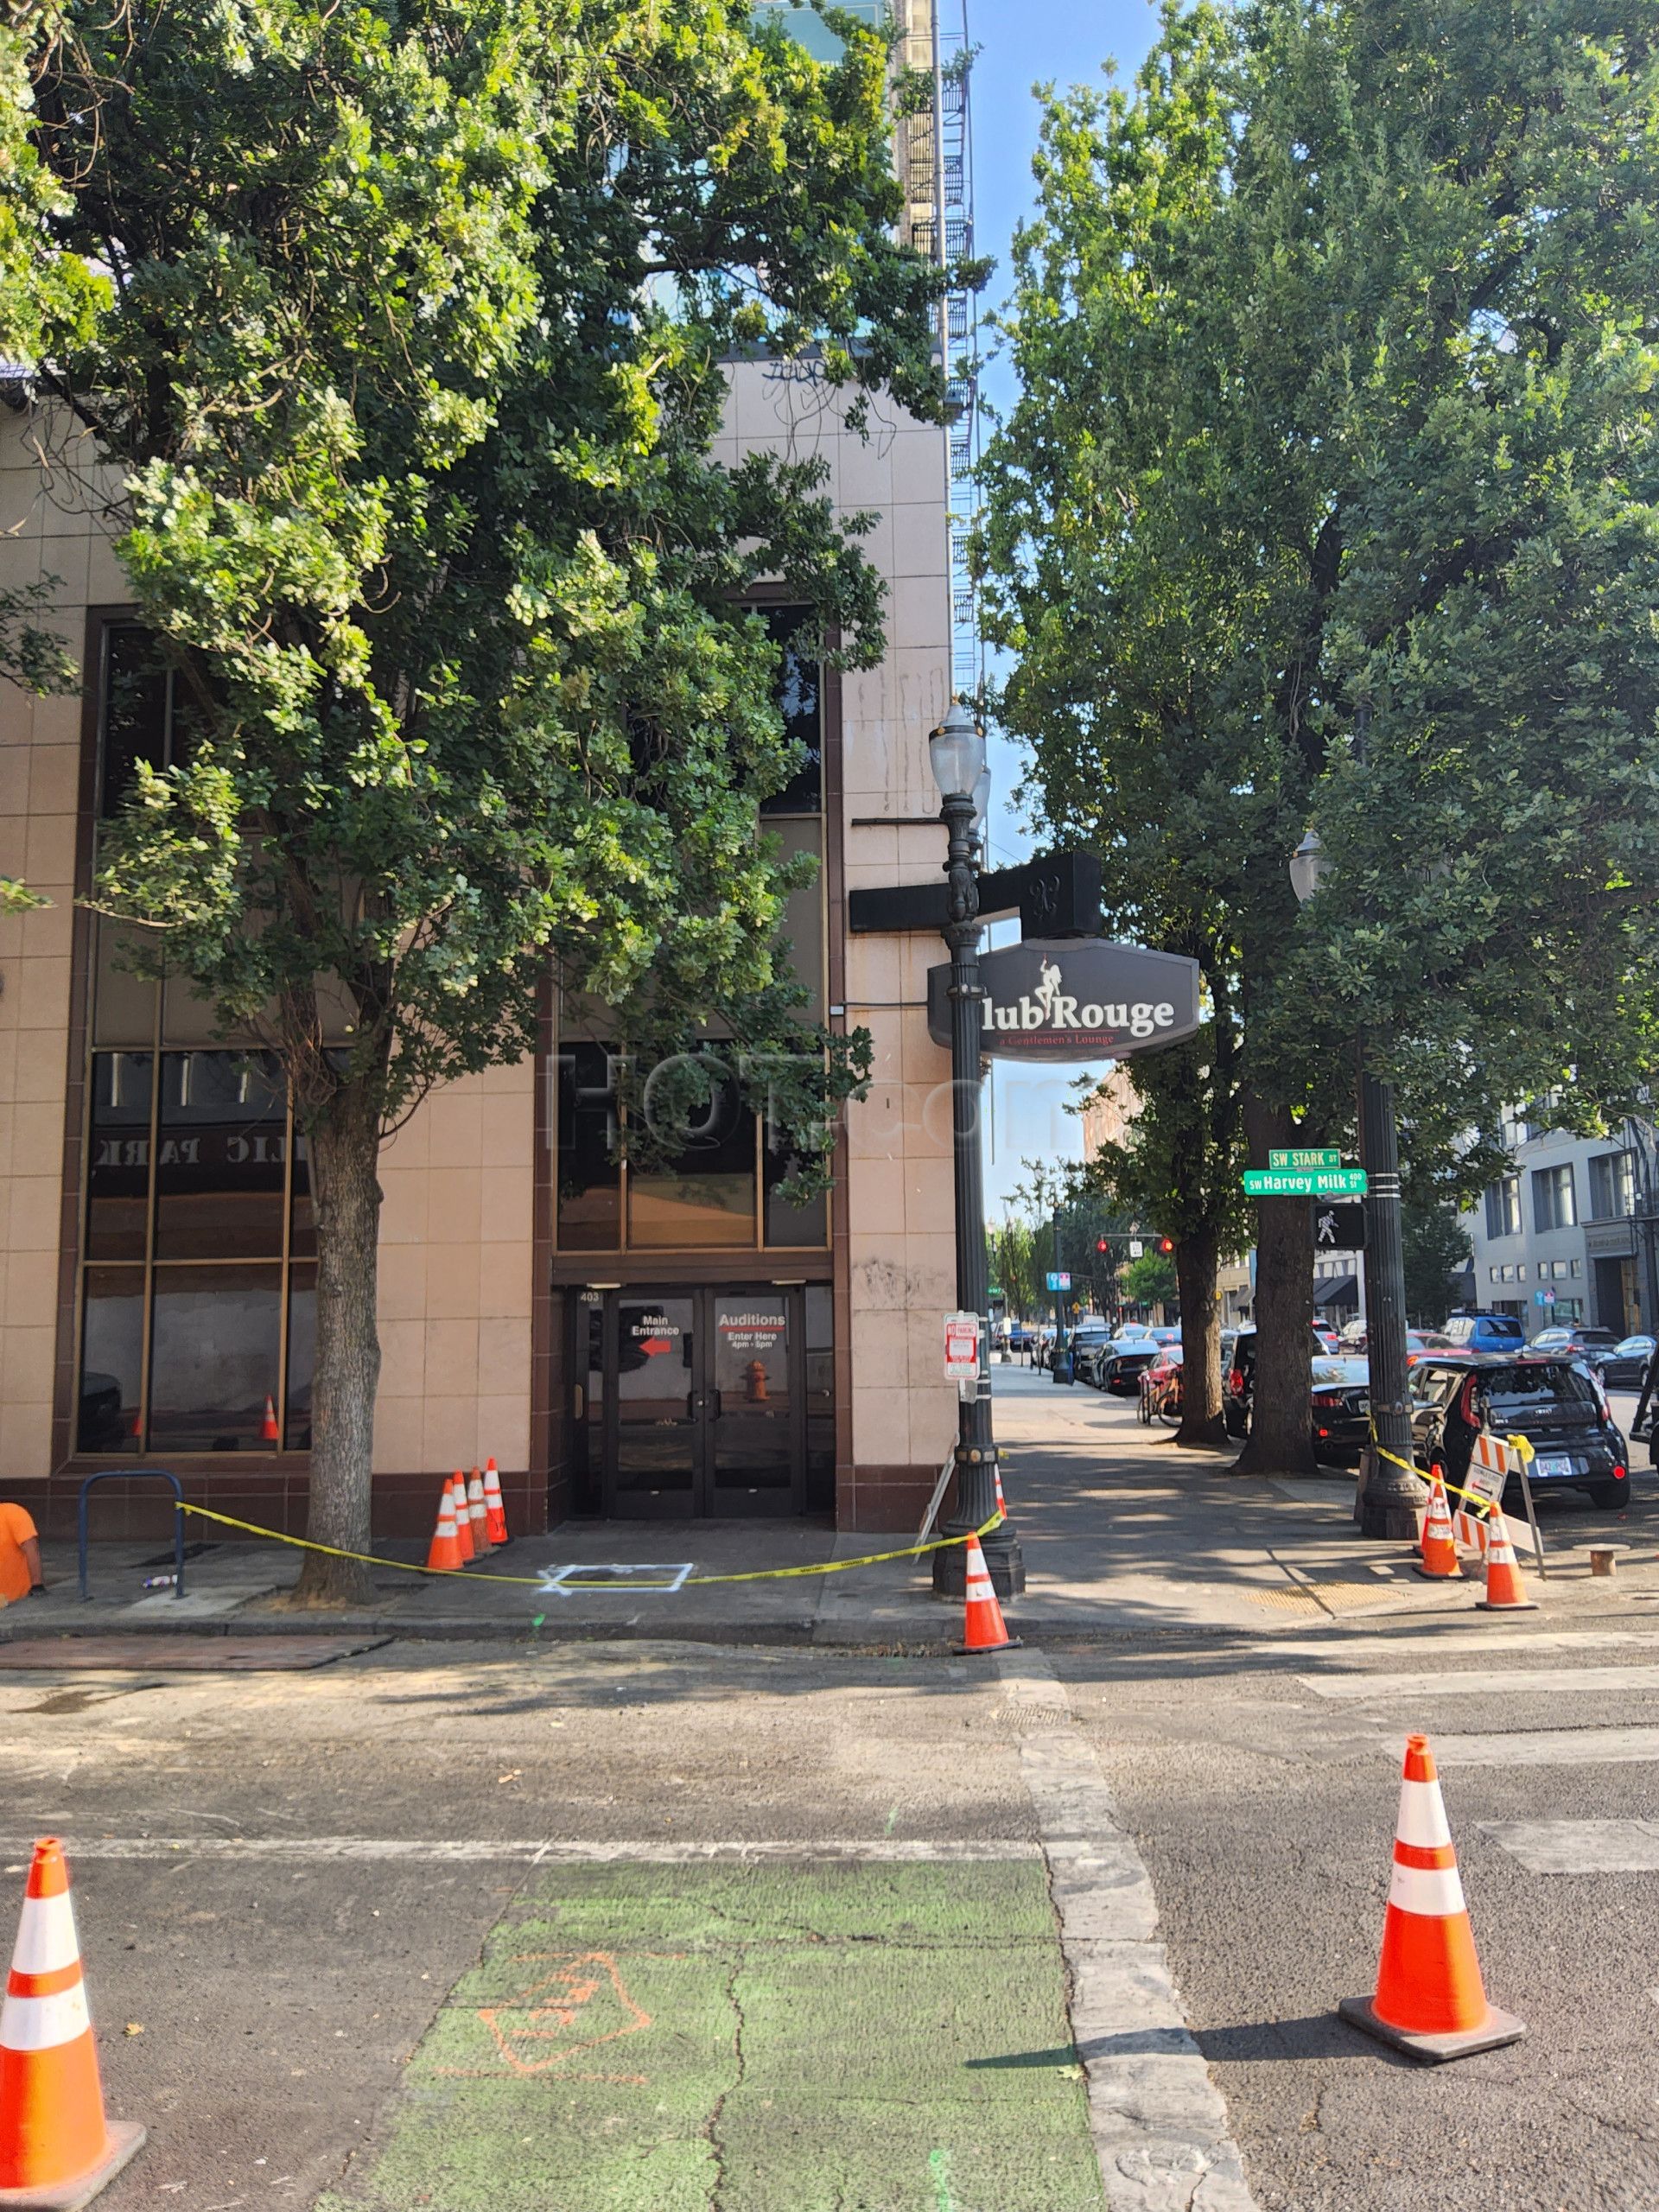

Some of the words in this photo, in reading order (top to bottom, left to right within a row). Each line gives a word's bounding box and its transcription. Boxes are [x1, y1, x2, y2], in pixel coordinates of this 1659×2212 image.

[982, 996, 1045, 1031] lub
[1051, 995, 1175, 1038] Rouge
[1008, 1034, 1072, 1046] Gentlemen's
[1075, 1033, 1115, 1046] Lounge
[1273, 1153, 1288, 1166] SW
[1292, 1152, 1325, 1166] STARK
[1328, 1154, 1338, 1163] ST
[1249, 1179, 1262, 1190] SW
[1263, 1176, 1313, 1193] Harvey
[1317, 1174, 1347, 1189] Milk
[580, 1292, 600, 1301] 403
[642, 1315, 669, 1325] Main
[719, 1313, 785, 1326] Auditions
[632, 1325, 680, 1336] Entrance
[728, 1332, 753, 1341] Enter
[754, 1332, 778, 1341] Here
[732, 1341, 749, 1350] 4pm
